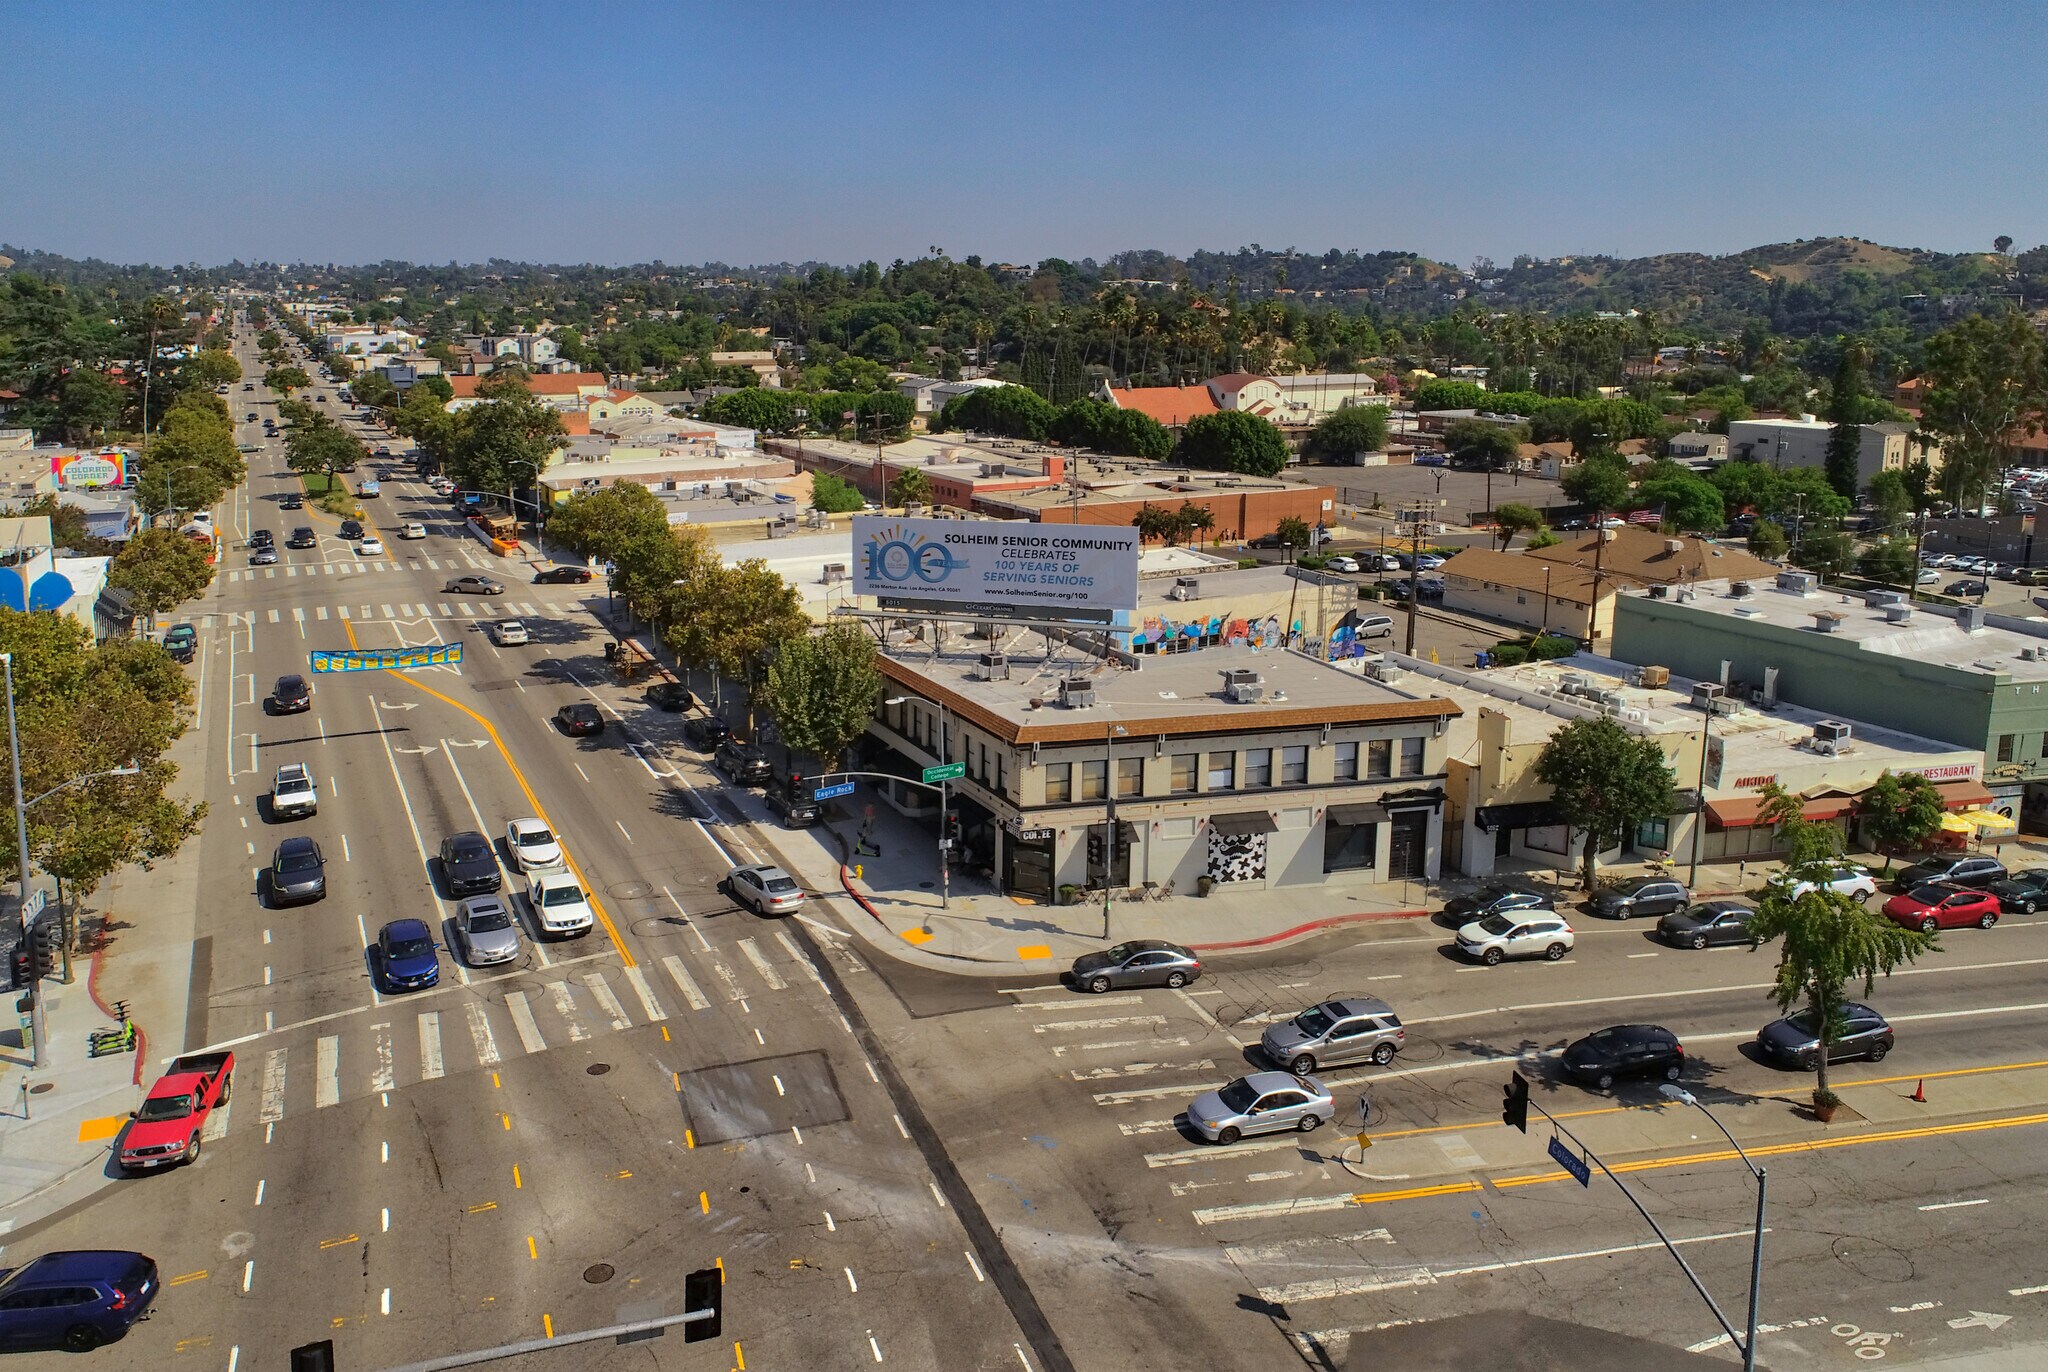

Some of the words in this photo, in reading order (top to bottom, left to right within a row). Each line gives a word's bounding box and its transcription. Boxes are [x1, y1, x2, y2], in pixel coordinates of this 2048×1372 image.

[65, 466, 113, 474] COLORADO
[944, 534, 998, 545] SOLHEIM
[1002, 536, 1048, 547] SENIOR
[1052, 538, 1133, 551] COMMUNITY
[1001, 548, 1076, 561] CELEBRATES
[863, 541, 953, 583] 100
[995, 560, 1016, 570] 100
[1020, 561, 1059, 572] YEARS
[1063, 563, 1080, 573] OF
[983, 572, 1037, 583] SERVING
[1040, 574, 1094, 586] SENIORS
[984, 588, 1088, 600] www.SolheimSenior.org/100
[927, 766, 954, 775] Occidental
[1923, 765, 1976, 779] RESTAURANT
[816, 789, 834, 797] Eagle
[1023, 830, 1051, 840] COFEE
[1552, 1143, 1586, 1179] Colorado
